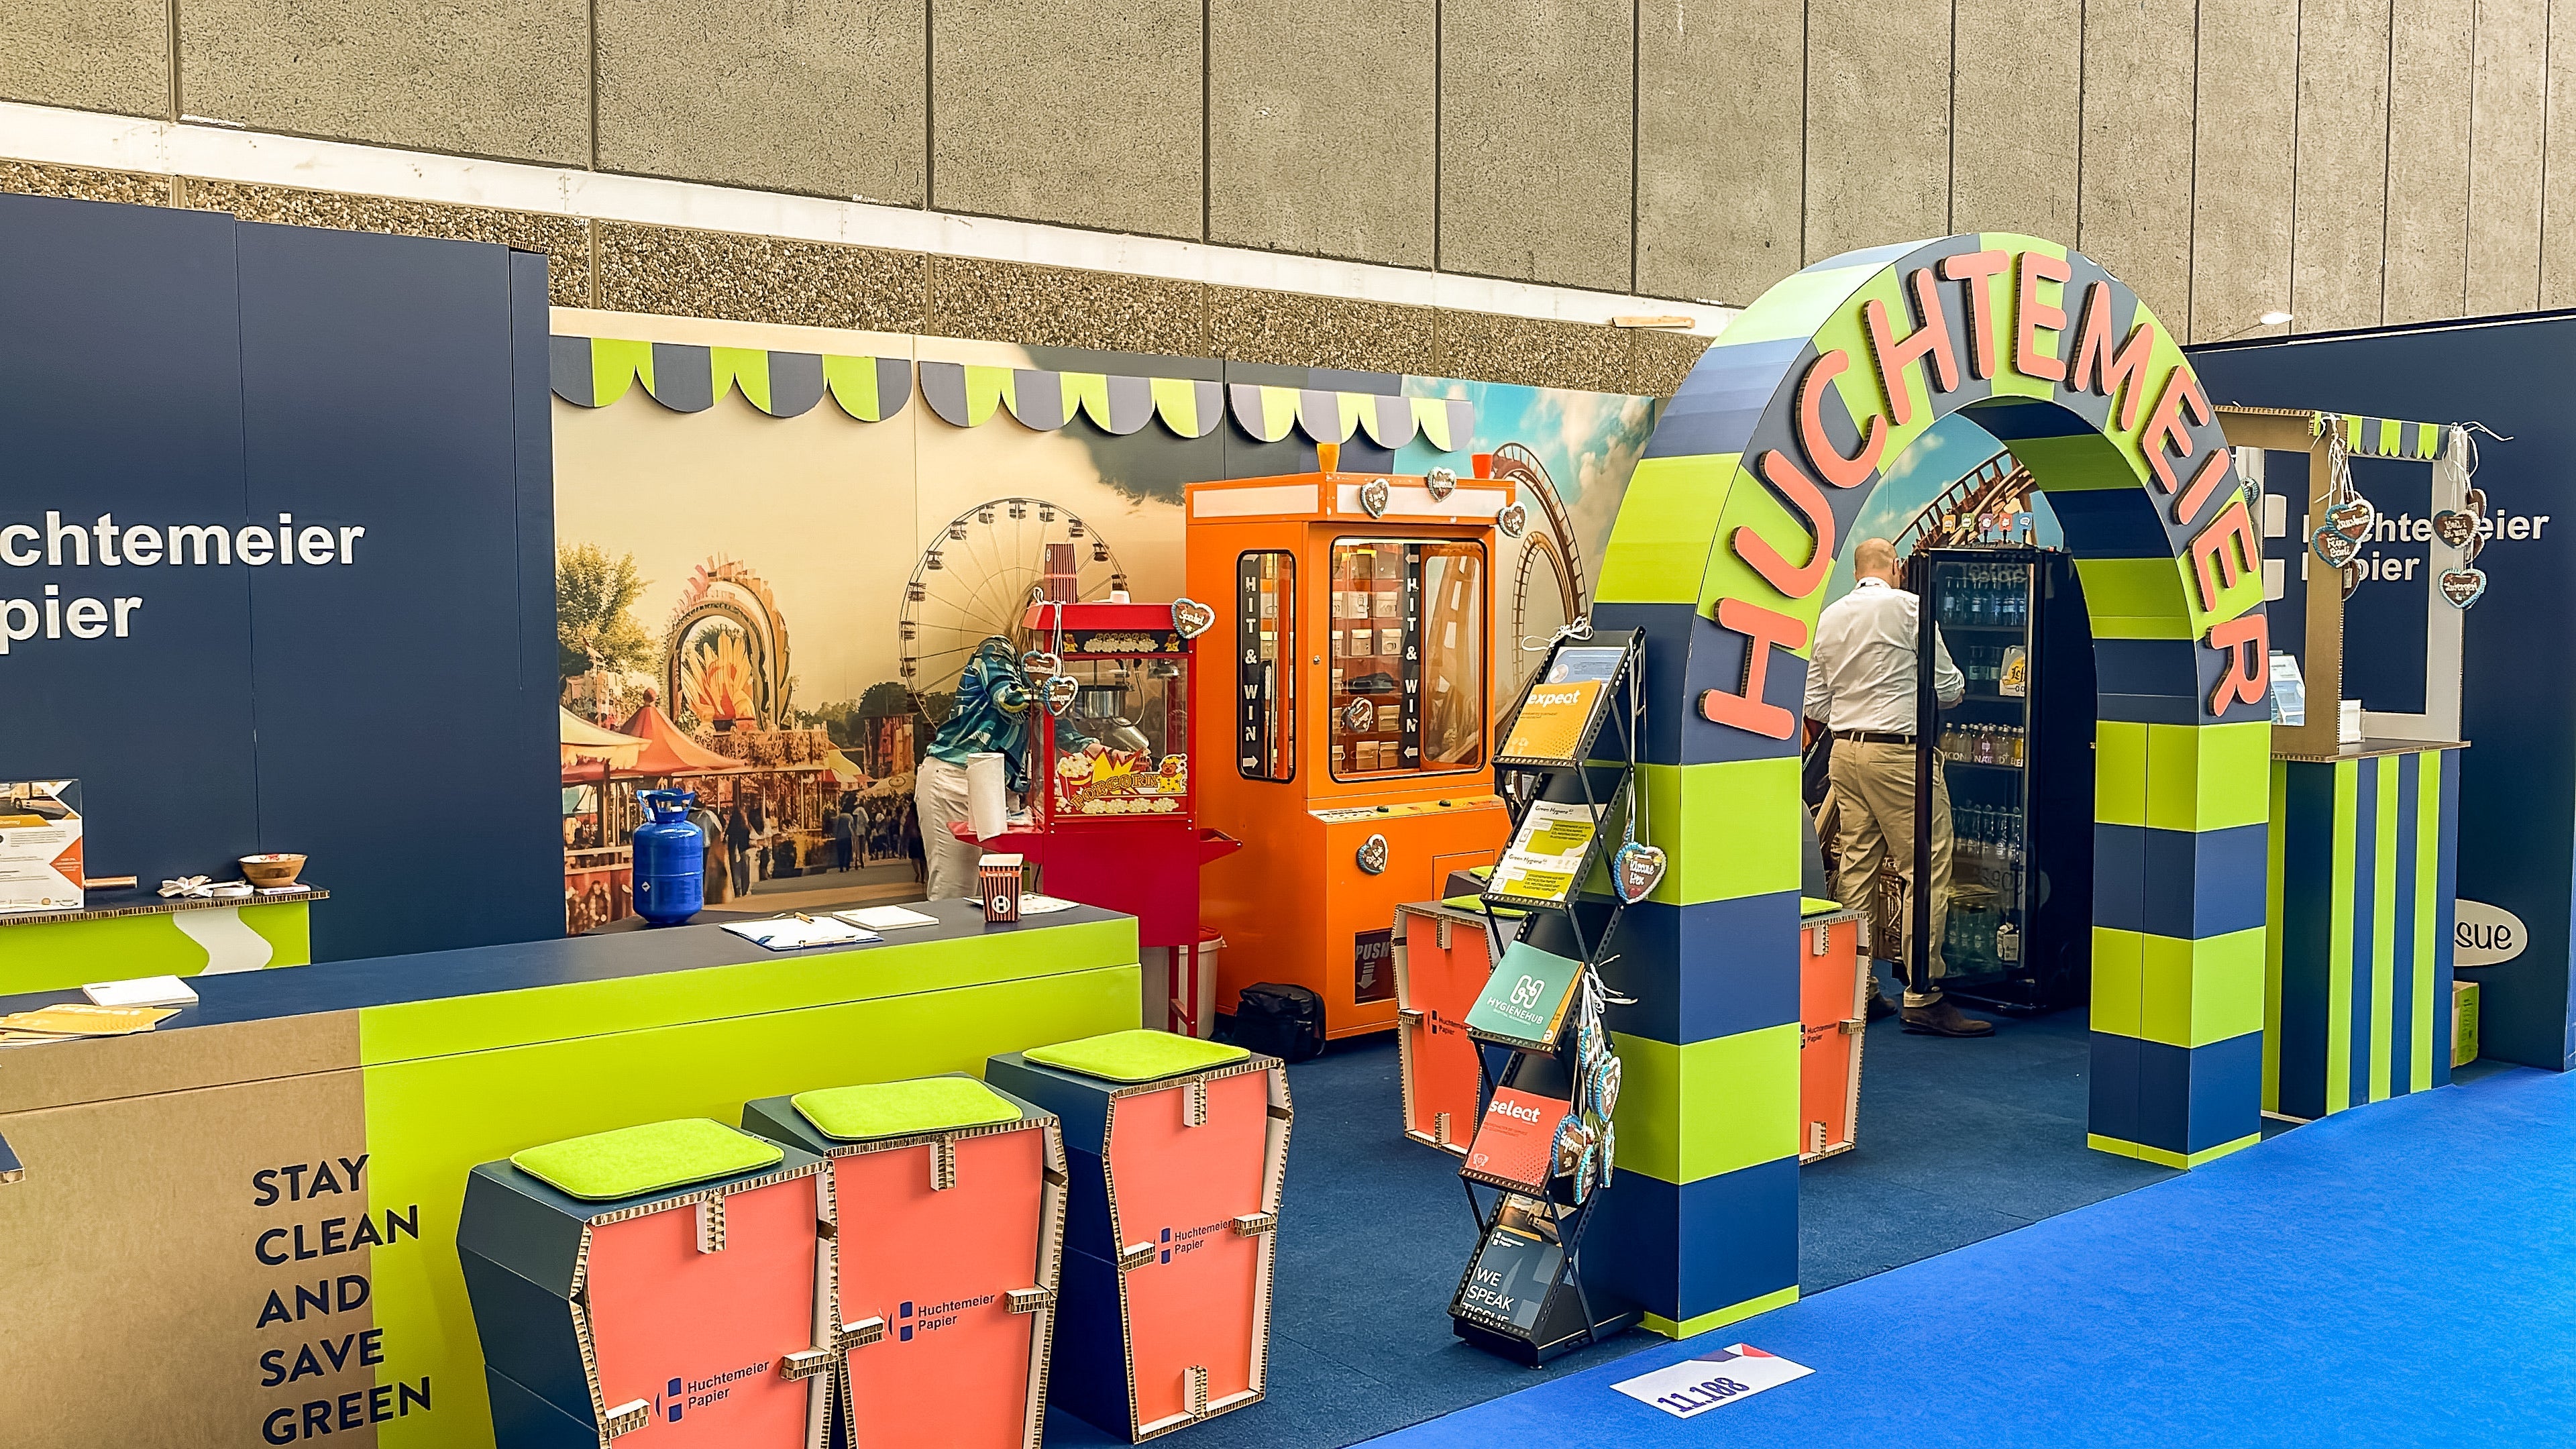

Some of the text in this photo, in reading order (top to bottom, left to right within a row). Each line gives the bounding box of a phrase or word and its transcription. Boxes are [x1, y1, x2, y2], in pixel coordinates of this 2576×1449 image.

[1703, 249, 2269, 741] HUCHTEMEIER
[0, 511, 366, 566] chtemeier
[2302, 509, 2550, 542] hteeier
[0, 584, 142, 655] pier
[1243, 576, 1258, 742] HIT & WIN
[1405, 577, 1419, 734] HIT & WIN
[1070, 773, 1161, 810] POPCORN
[1355, 941, 1391, 961] PUSH
[1487, 996, 1544, 1025] HYGIENEHUB
[252, 1153, 370, 1207] STAY
[255, 1205, 419, 1266] CLEAN
[1175, 1219, 1232, 1242] Huchtemeier
[1175, 1238, 1203, 1255] Papier
[1477, 1266, 1503, 1287] WE
[256, 1275, 370, 1329] AND
[918, 1294, 996, 1318] Huchtemeier
[1466, 1285, 1515, 1311] SPEAK
[918, 1313, 958, 1332] Papier
[259, 1328, 384, 1387] SAVE
[688, 1360, 769, 1395] Huchtemeier
[262, 1376, 431, 1446] GREEN
[688, 1386, 731, 1409] Papier
